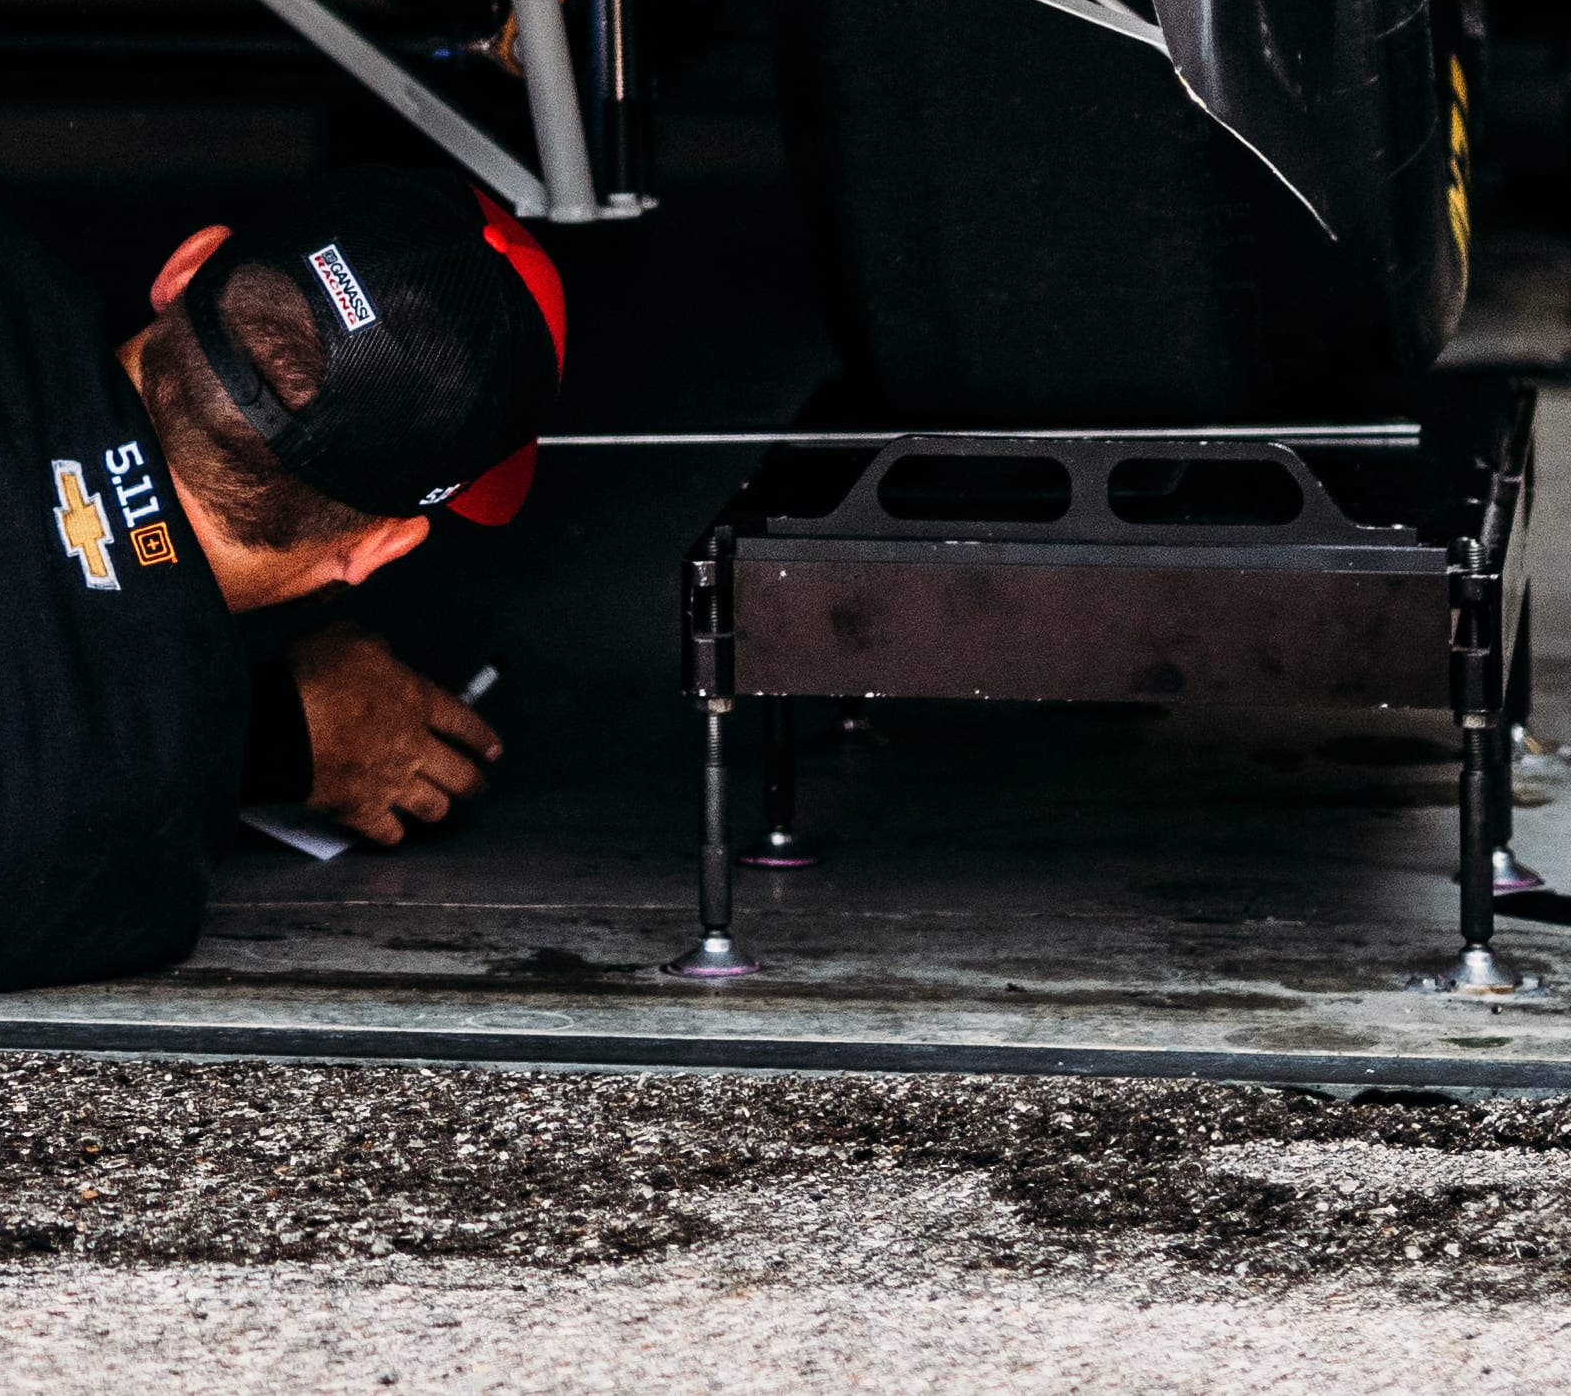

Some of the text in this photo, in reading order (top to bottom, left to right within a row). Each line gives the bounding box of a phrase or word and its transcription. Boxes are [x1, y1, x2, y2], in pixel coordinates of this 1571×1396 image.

[314, 255, 357, 325] RACING
[330, 263, 370, 321] GANASSI
[104, 440, 161, 529] 5.11
